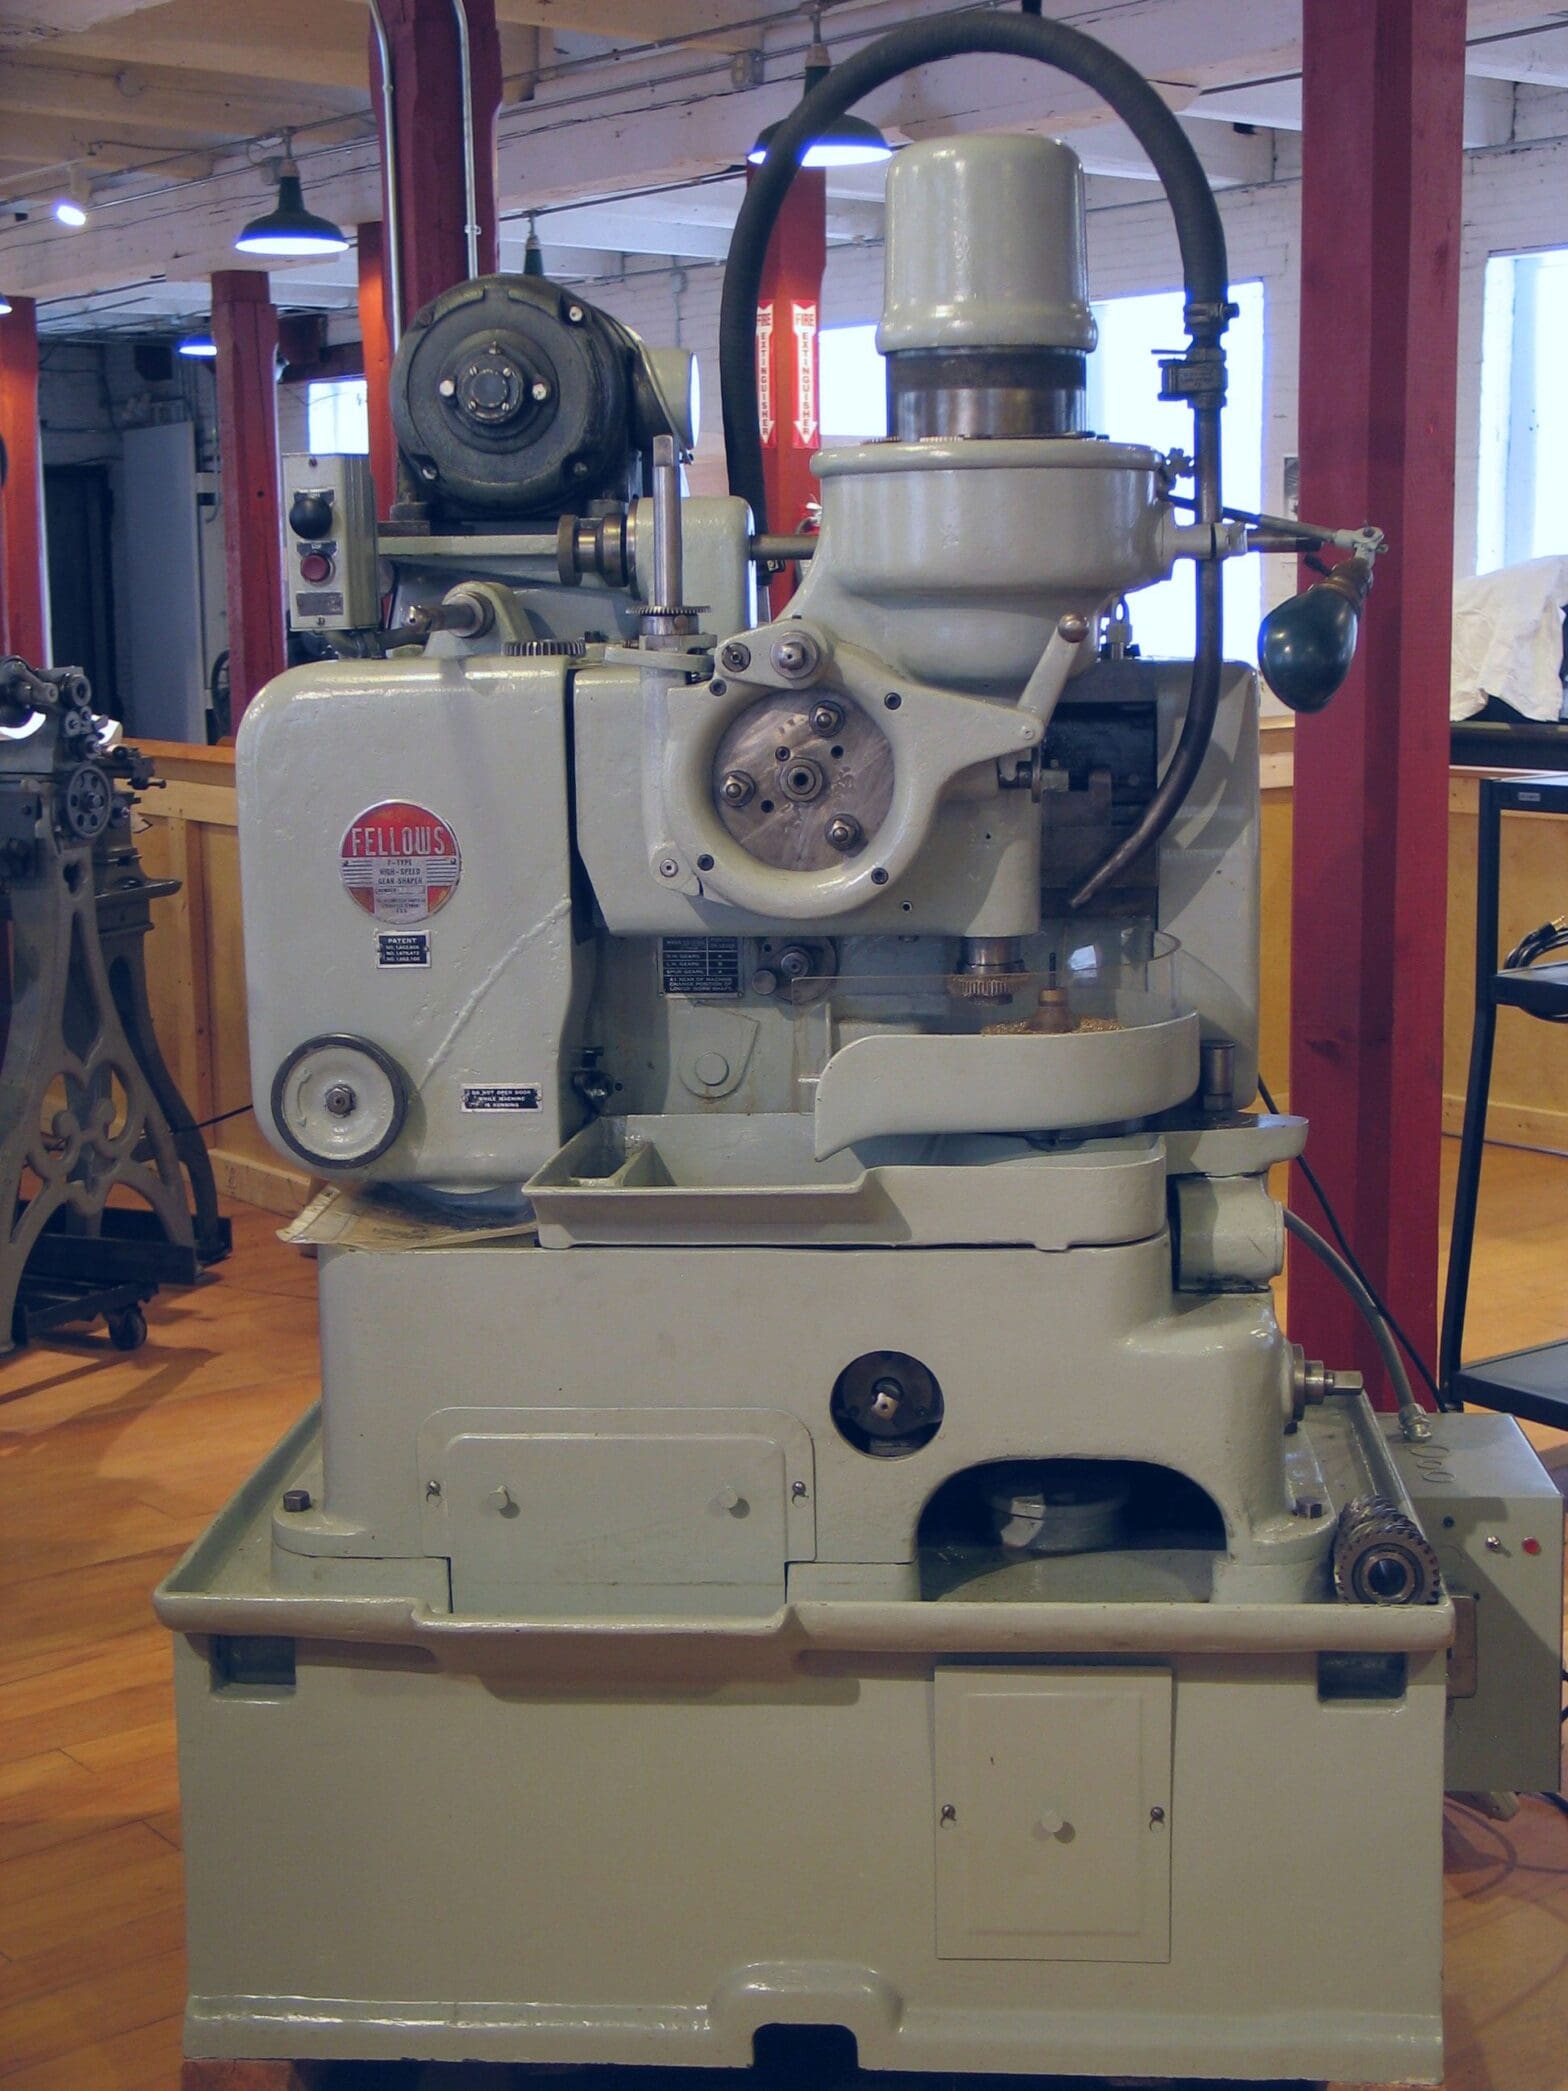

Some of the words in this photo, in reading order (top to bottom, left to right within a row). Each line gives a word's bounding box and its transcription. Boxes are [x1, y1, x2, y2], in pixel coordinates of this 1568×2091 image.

[795, 312, 814, 326] FIRE
[760, 332, 769, 436] EXTINGUISHER
[802, 332, 810, 436] EXTINGUISHER
[351, 826, 446, 857] FELLOWS
[388, 937, 417, 945] PATENT
